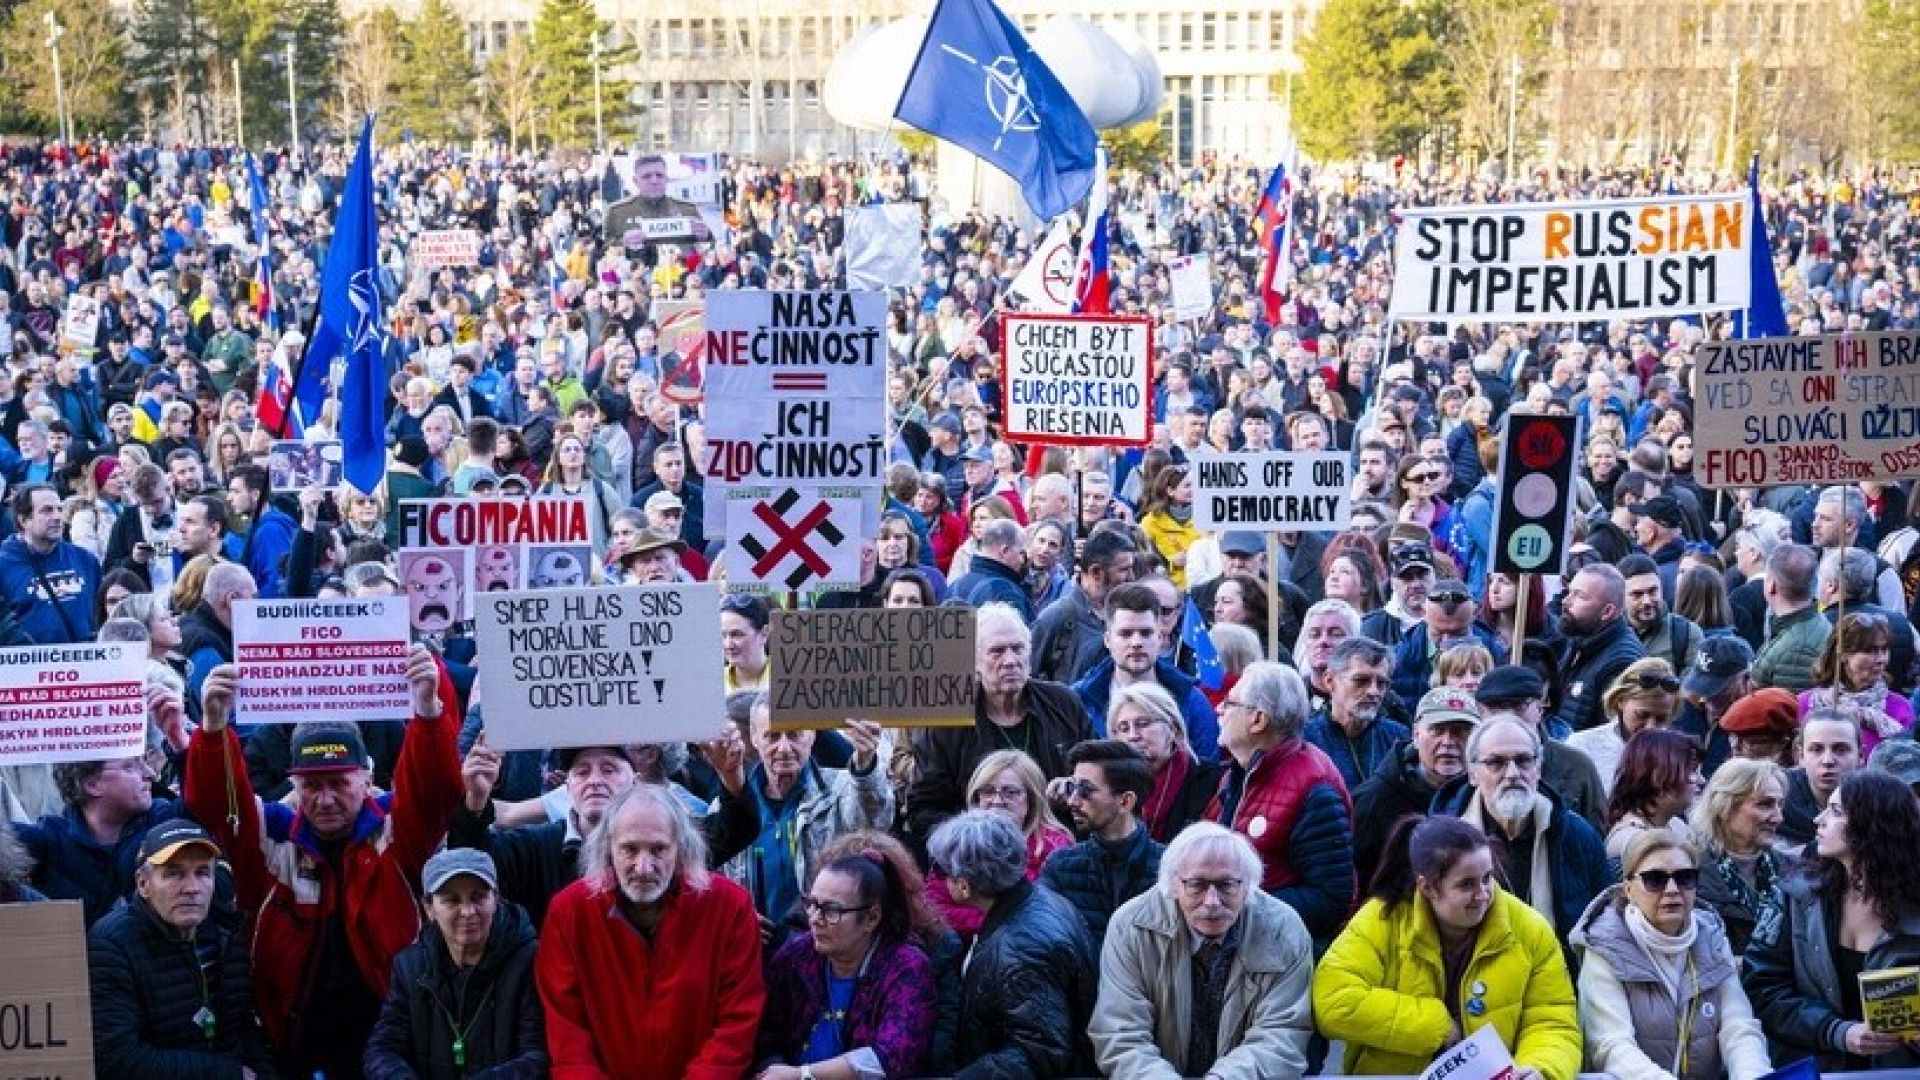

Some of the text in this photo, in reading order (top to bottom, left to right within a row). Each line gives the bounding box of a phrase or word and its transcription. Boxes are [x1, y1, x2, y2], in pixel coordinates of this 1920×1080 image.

[648, 221, 684, 233] AGENT
[1415, 216, 1526, 263] STOP
[1428, 255, 1716, 313] IMPERIALISM
[771, 292, 856, 328] NAŠA
[706, 326, 879, 366] NEČINNOSŤ
[1015, 324, 1076, 348] CHCEM
[1705, 340, 1823, 374] ZASTAVME
[1012, 378, 1140, 409] EURÓPSKEHO
[1803, 375, 1836, 403] ONI
[778, 401, 830, 437] ICH
[1026, 406, 1126, 435] RIEŠENIA
[1744, 406, 1847, 444] SLOVÁCI
[707, 434, 884, 482] ZLOČINNOSŤ
[1707, 448, 1767, 484] FICO
[1199, 460, 1344, 488] HANDS OFF OUR
[400, 496, 588, 547] FICOMPÁNIA
[1212, 495, 1340, 523] DEMOCRACY
[1516, 537, 1542, 557] EU
[494, 592, 683, 625] SMER HLAS SNS
[301, 626, 342, 639] FICO
[509, 622, 673, 653] MORÁLNE DNO
[907, 610, 968, 641] OPICE
[240, 646, 278, 658] NEMÁ
[283, 645, 312, 657] RÁD
[781, 643, 934, 674] VYPADNITE DO
[39, 671, 79, 683] FICO
[240, 662, 407, 679] PREDHADZUJE NÁS
[308, 683, 408, 696] HRDLOREZOM
[529, 679, 640, 709] ODSTÚPTE
[776, 673, 975, 709] ZASRANÉHO RUSKA
[109, 702, 142, 716] NÁS
[241, 703, 248, 712] A
[43, 723, 142, 738] HRDLOREZOM
